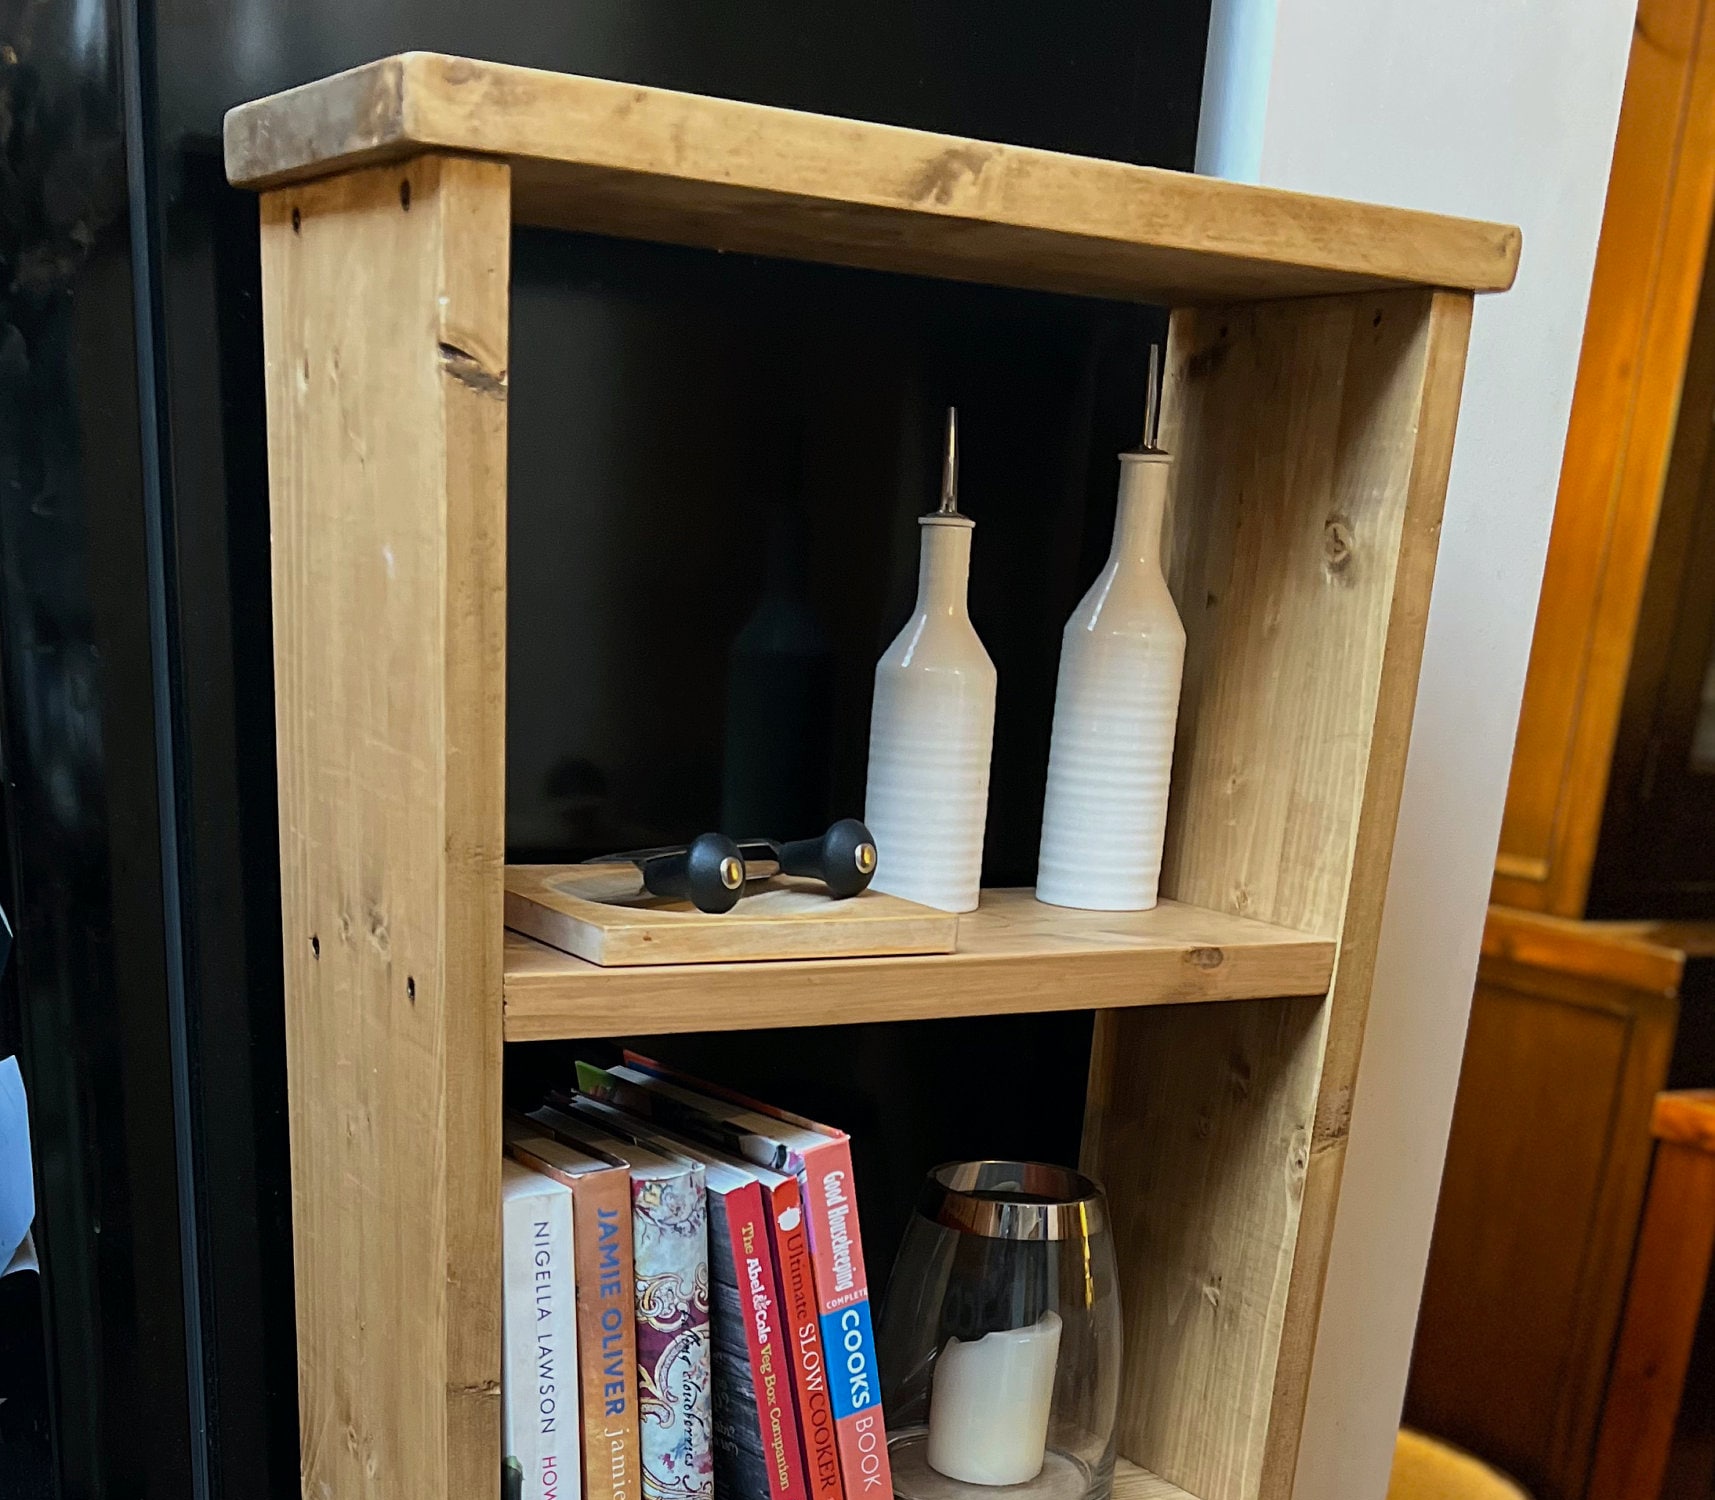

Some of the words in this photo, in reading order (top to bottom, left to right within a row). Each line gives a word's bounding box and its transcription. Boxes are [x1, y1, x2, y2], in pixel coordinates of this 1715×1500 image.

[822, 1170, 848, 1207] Good
[533, 1221, 553, 1322] NIGELLA
[597, 1208, 621, 1299] JAMIE
[742, 1221, 755, 1255] The
[786, 1233, 808, 1321] Ultimate
[827, 1204, 857, 1293] Housekeeping
[537, 1333, 556, 1434] LAWSON
[601, 1308, 625, 1417] OLIVER
[760, 1343, 772, 1375] Veg
[764, 1373, 777, 1406] Box
[841, 1308, 871, 1409] COOKS
[769, 1407, 790, 1492] Companion
[855, 1415, 882, 1492] BOOK
